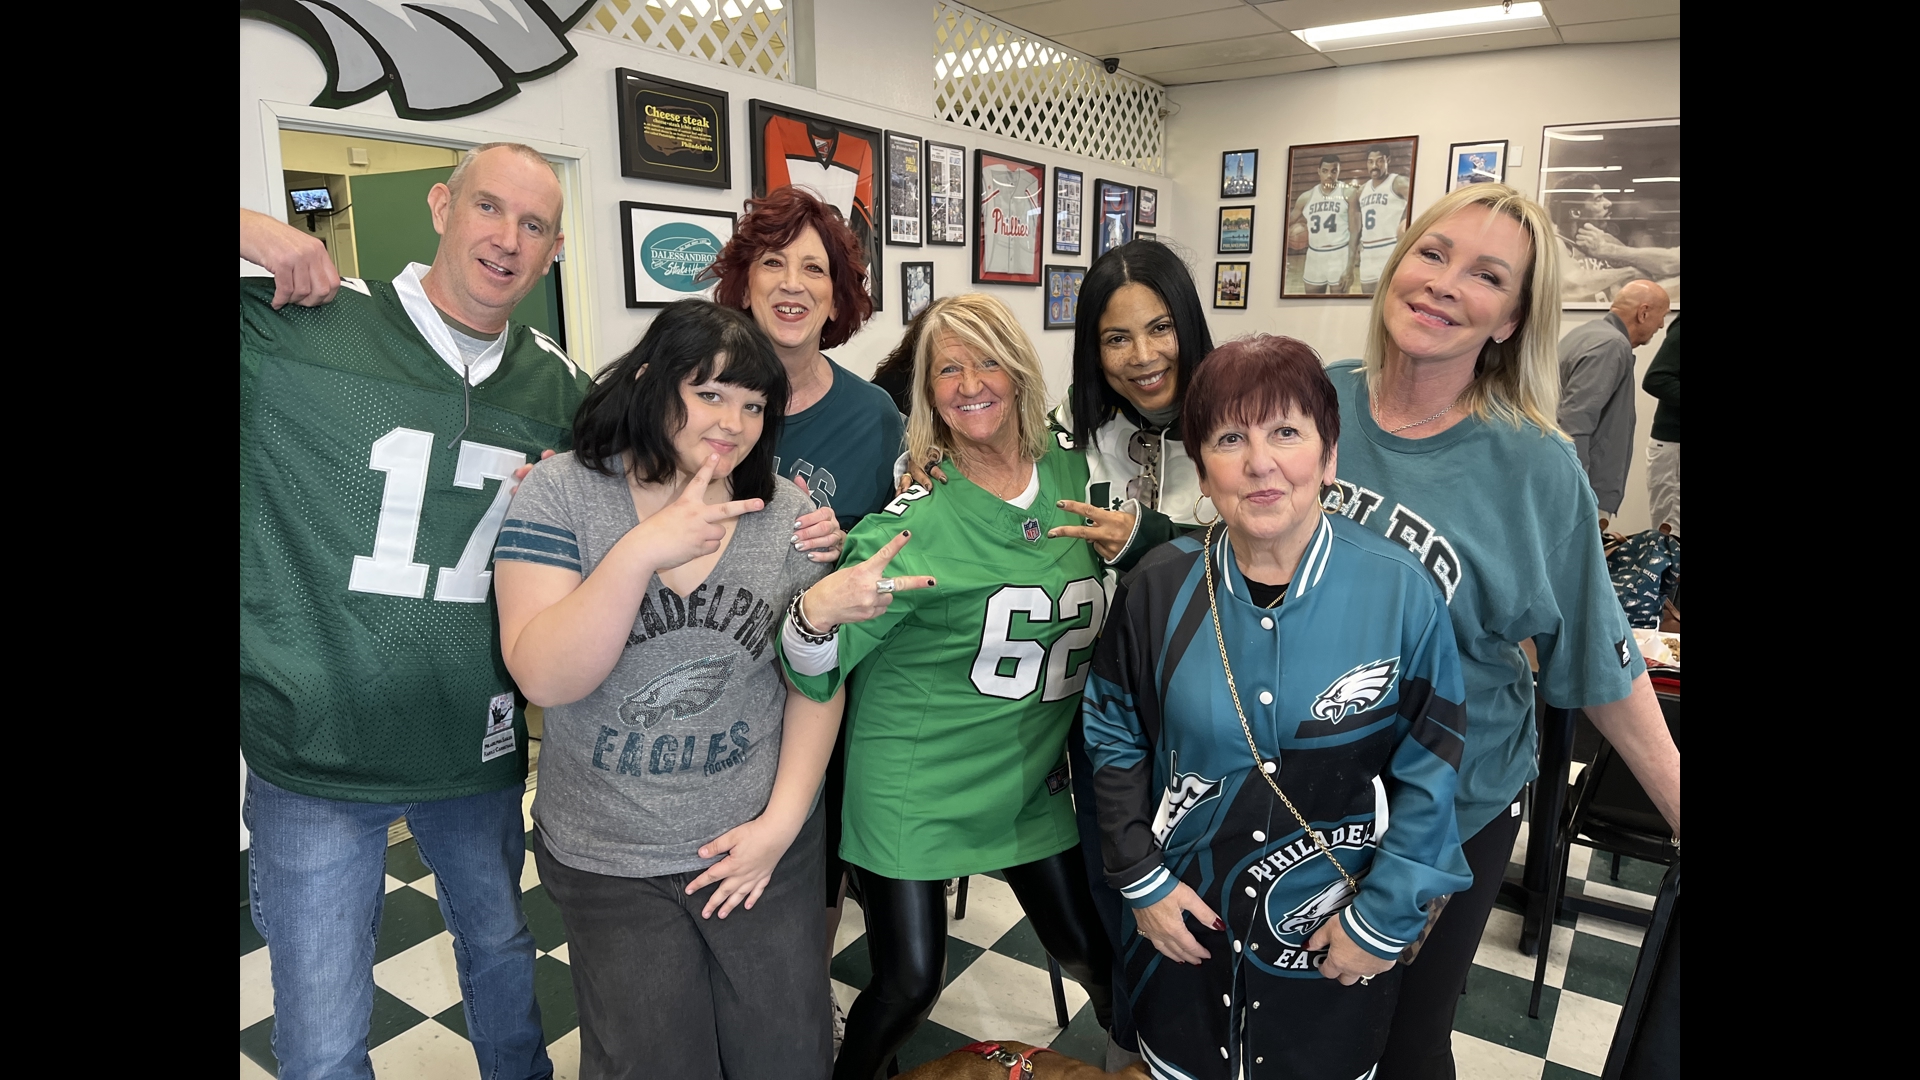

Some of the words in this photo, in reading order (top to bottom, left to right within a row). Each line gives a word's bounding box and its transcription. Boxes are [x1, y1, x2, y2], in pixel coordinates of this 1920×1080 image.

[644, 104, 680, 122] Cheese
[682, 115, 710, 128] steak
[681, 141, 713, 151] Philadelphia
[1309, 201, 1341, 215] SIXERS
[1365, 208, 1376, 230] 6
[992, 207, 1030, 237] Phillies
[1310, 213, 1337, 234] 34
[348, 426, 527, 603] 17
[1025, 527, 1039, 540] NFL
[625, 583, 775, 661] LADELPHIA
[968, 576, 1106, 703] 62
[1273, 949, 1328, 969] EAG
